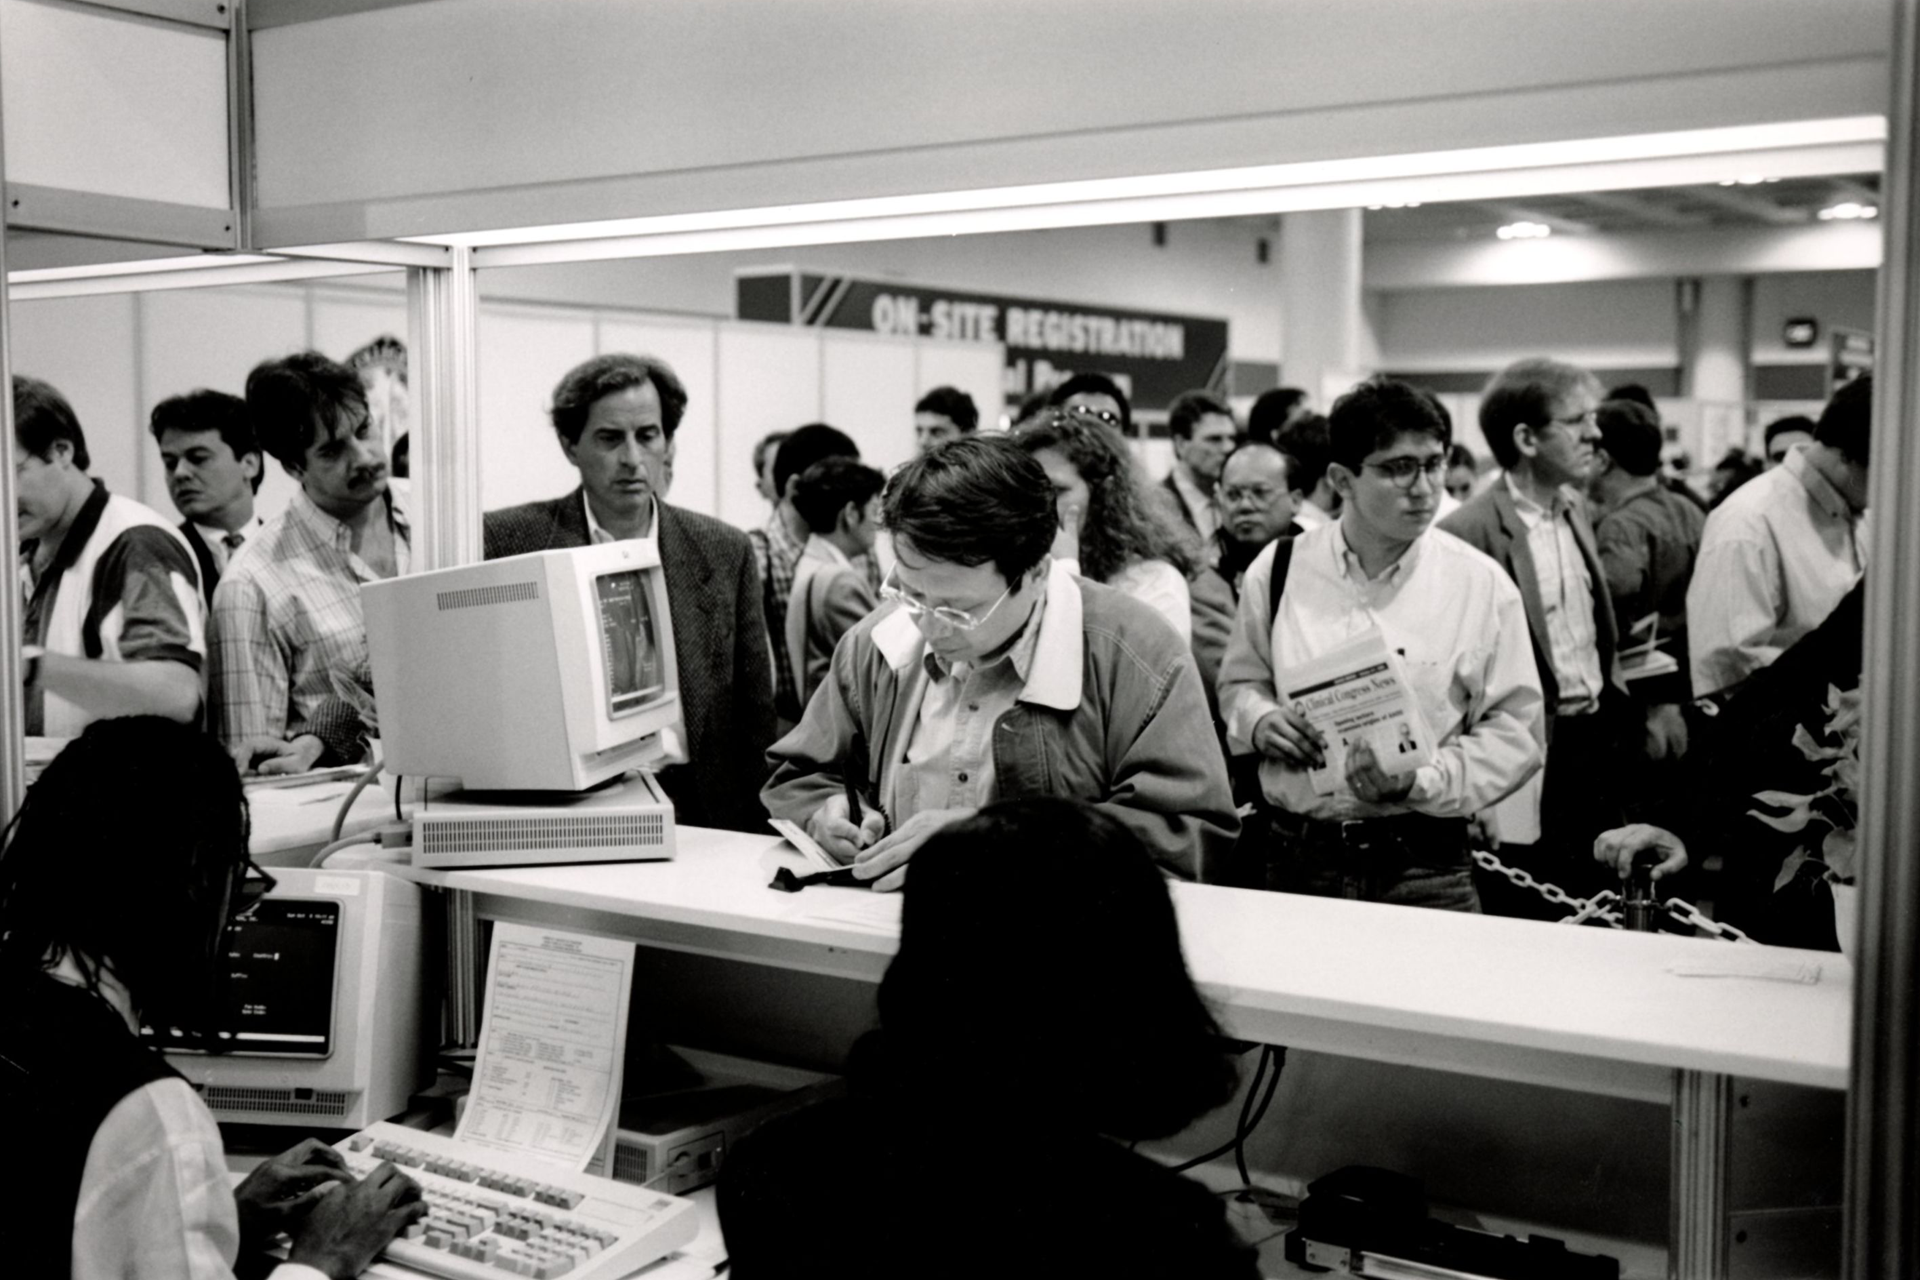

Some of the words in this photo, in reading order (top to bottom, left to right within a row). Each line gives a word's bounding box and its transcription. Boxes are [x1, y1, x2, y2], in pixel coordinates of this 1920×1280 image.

[871, 293, 999, 341] ON-SITE
[1005, 306, 1185, 360] REGISTRATION
[1306, 691, 1334, 711] Clinical
[1334, 685, 1371, 702] Congress
[1370, 676, 1396, 691] News
